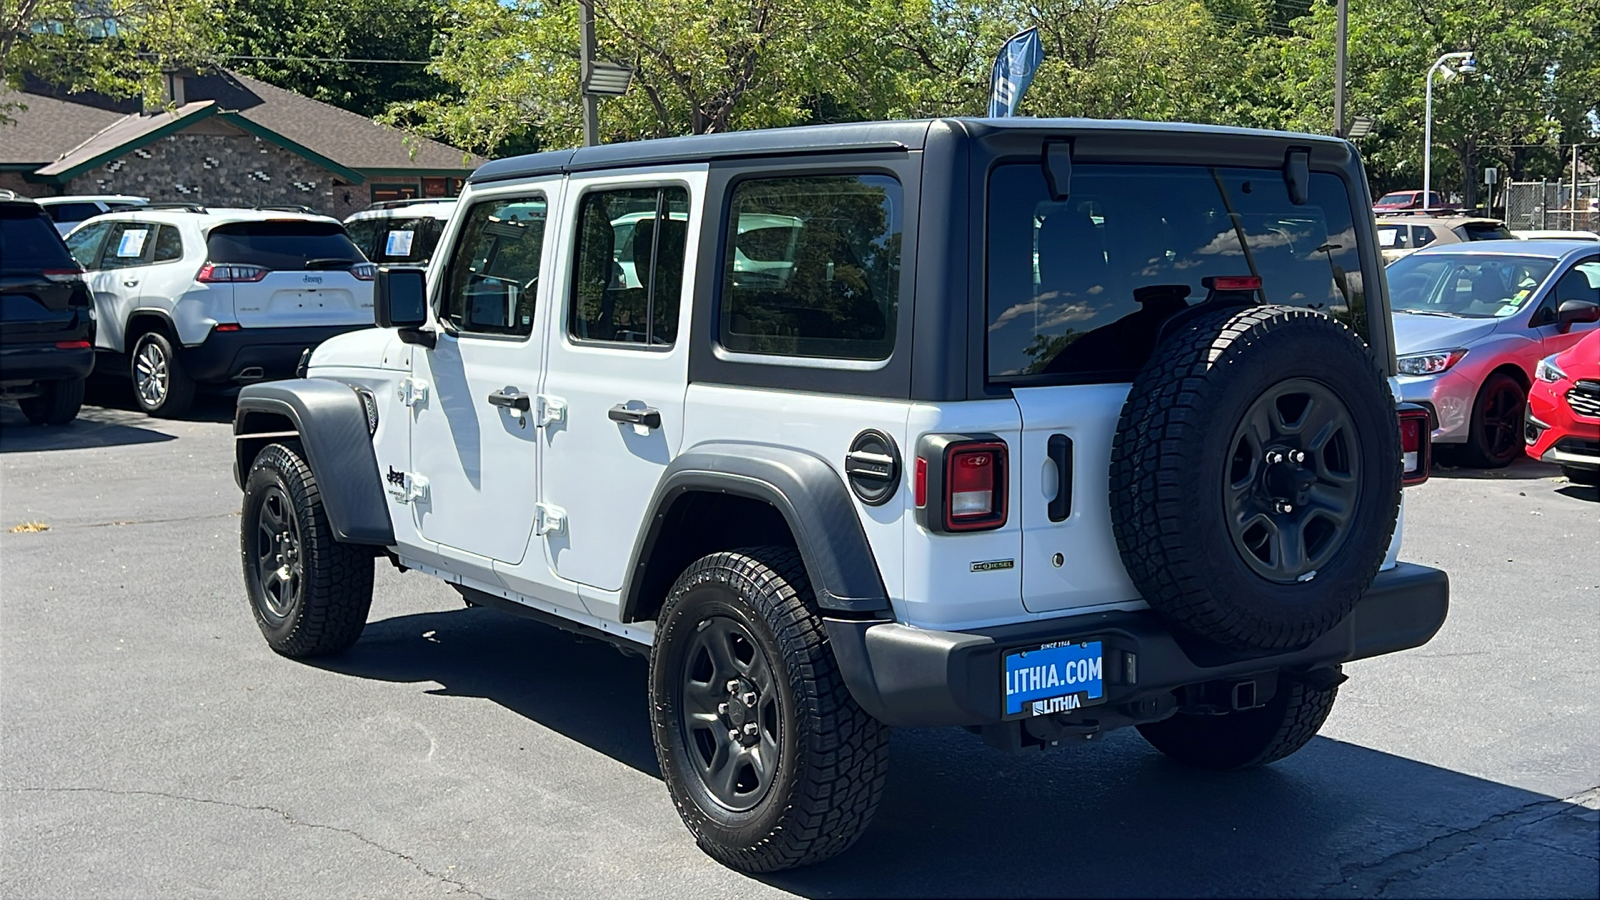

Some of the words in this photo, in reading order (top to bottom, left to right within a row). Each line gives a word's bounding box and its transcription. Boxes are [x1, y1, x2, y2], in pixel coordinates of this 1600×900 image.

[303, 274, 323, 285] Jeep
[1040, 642, 1057, 650] SINCE
[1006, 656, 1102, 696] LITHIA.COM
[1043, 694, 1081, 715] LITHIA
